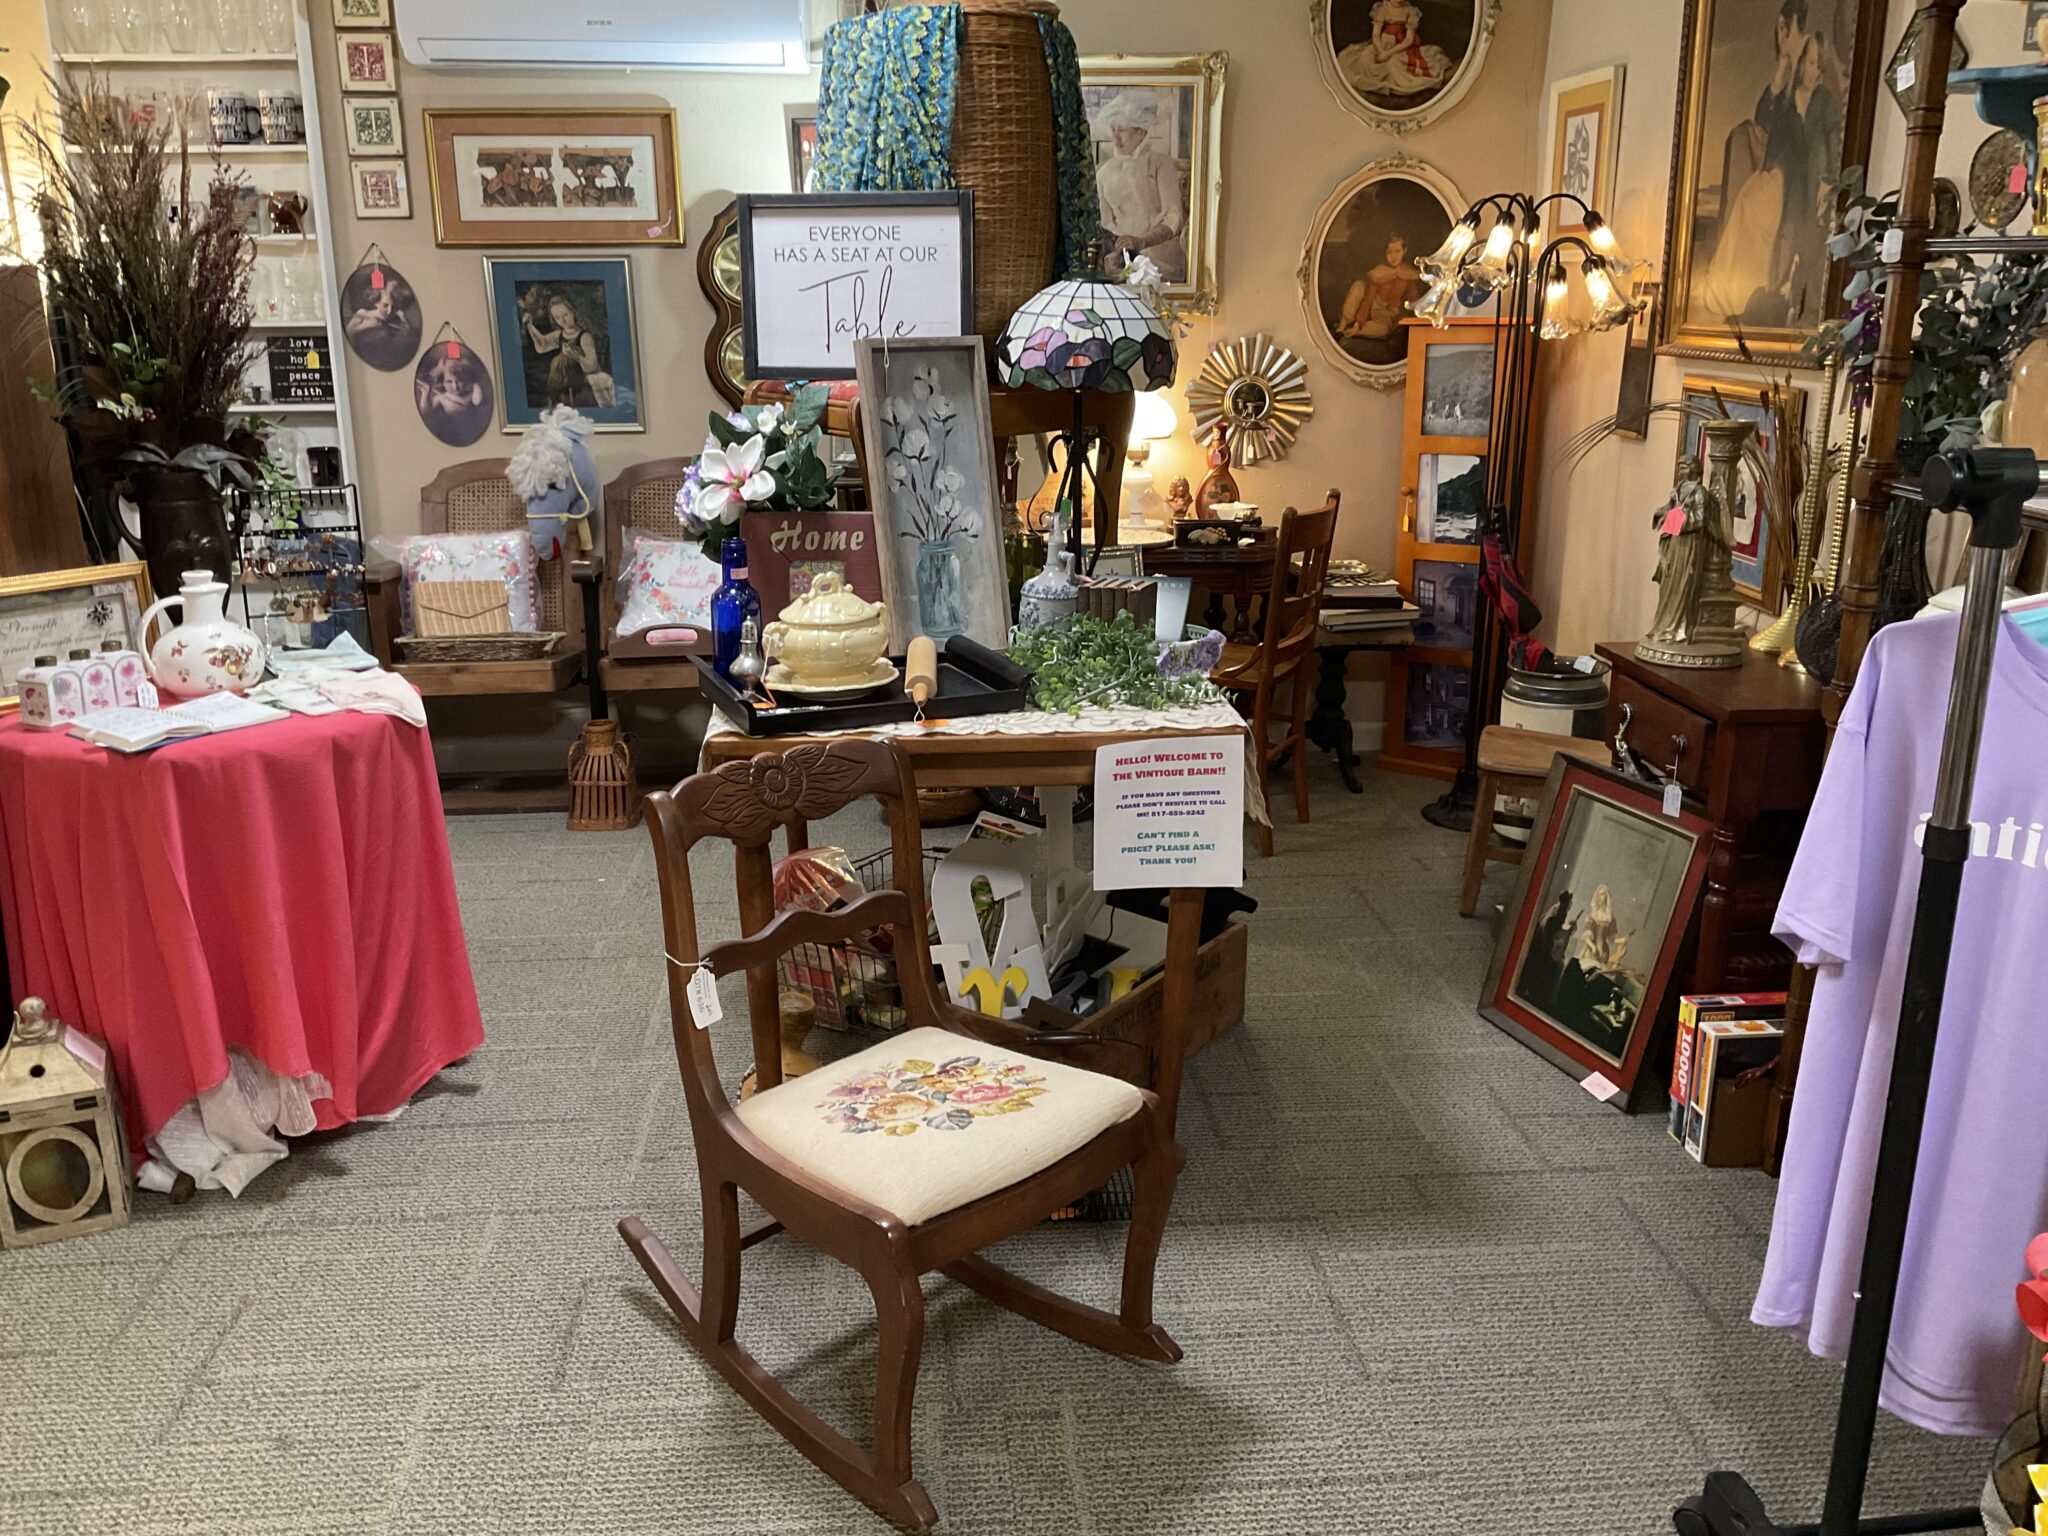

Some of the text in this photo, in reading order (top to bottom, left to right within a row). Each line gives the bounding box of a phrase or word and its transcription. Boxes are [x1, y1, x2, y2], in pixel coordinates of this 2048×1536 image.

[809, 225, 901, 241] EVERYONE
[774, 246, 938, 262] HAS A SEAT AT OUR
[798, 264, 917, 353] Table
[289, 372, 321, 382] peace
[290, 386, 323, 397] faith
[770, 520, 865, 553] Home
[1115, 752, 1223, 766] HELLO! WELCOME TO
[1112, 767, 1226, 781] THE VINTIQUE BARN!!
[1136, 831, 1166, 840] CAN'T
[1121, 843, 1215, 853] PRICE? PLEASE ASK!
[1175, 856, 1197, 864] YOU!
